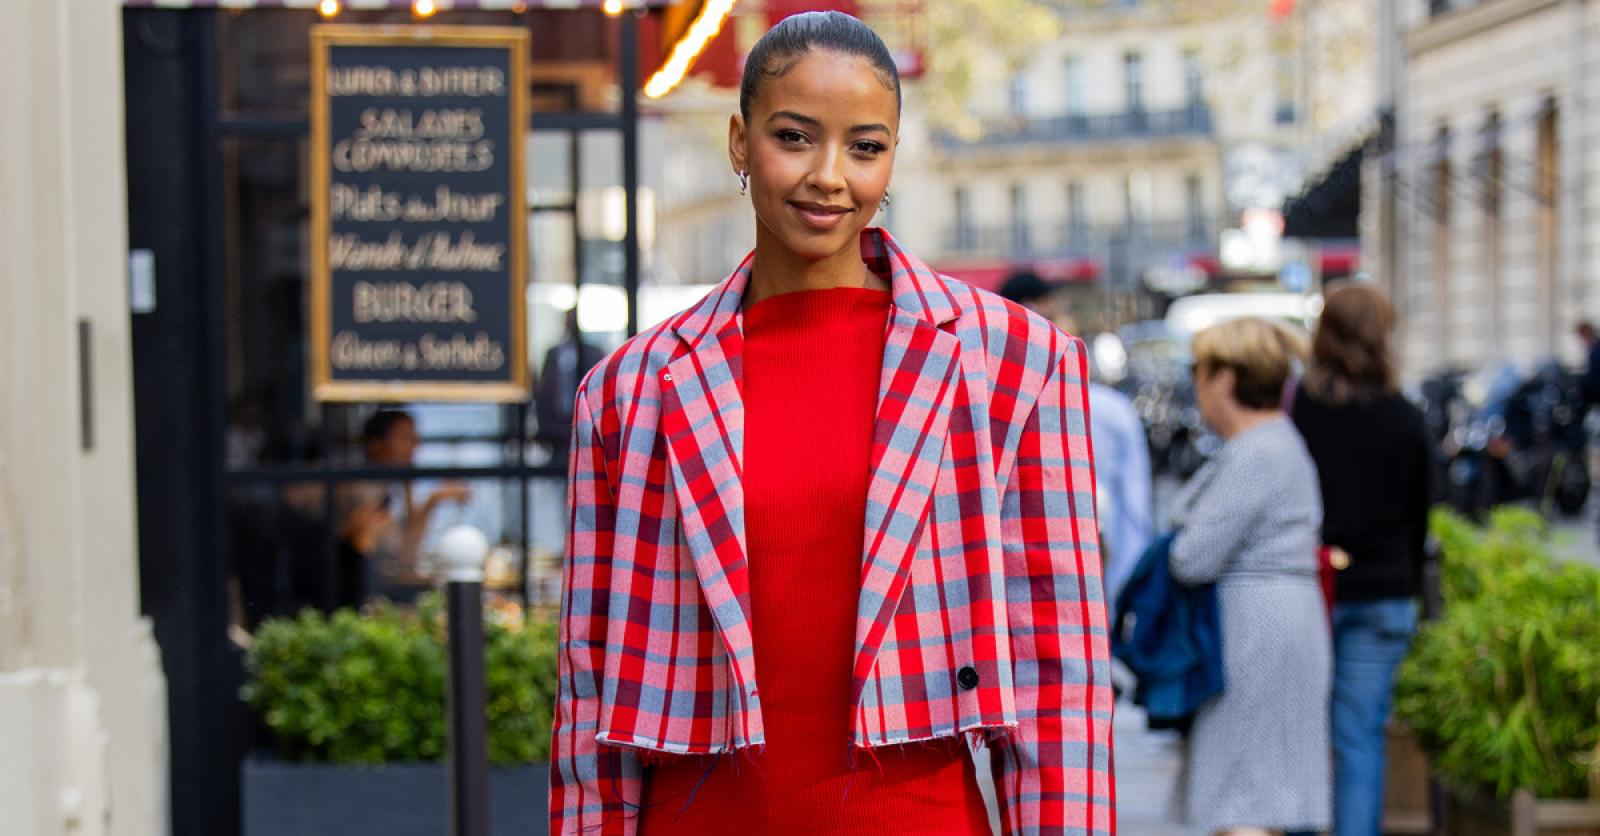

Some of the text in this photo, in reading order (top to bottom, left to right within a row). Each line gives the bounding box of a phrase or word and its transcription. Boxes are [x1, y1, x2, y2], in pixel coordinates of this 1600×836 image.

[400, 69, 416, 96] &
[356, 109, 483, 139] SALADES
[332, 183, 399, 221] Plats
[433, 185, 502, 221] Jour
[354, 281, 476, 322] BURGER
